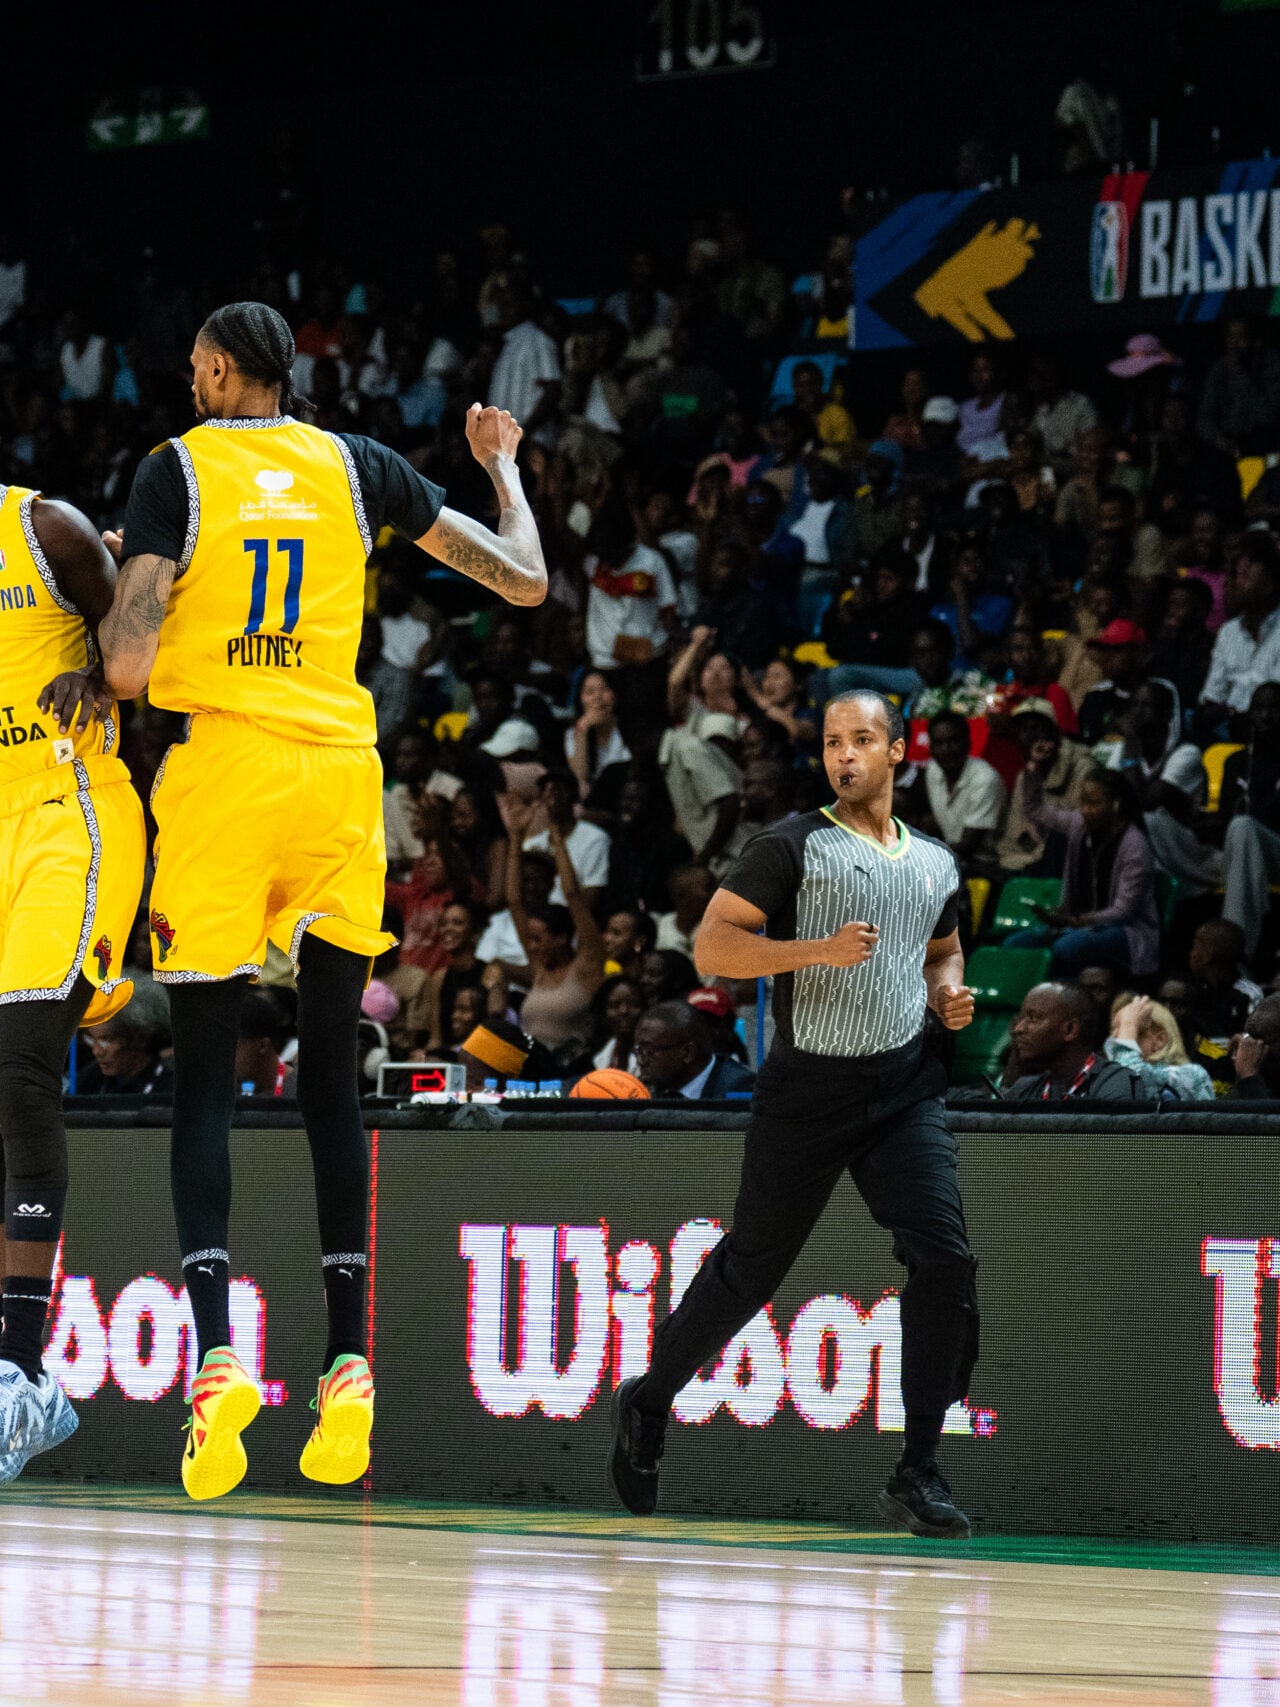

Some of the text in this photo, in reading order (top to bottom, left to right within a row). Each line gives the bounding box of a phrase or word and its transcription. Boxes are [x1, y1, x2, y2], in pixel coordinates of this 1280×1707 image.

[648, 0, 764, 70] 105
[243, 539, 304, 636] 11
[227, 635, 303, 668] PUTNEY
